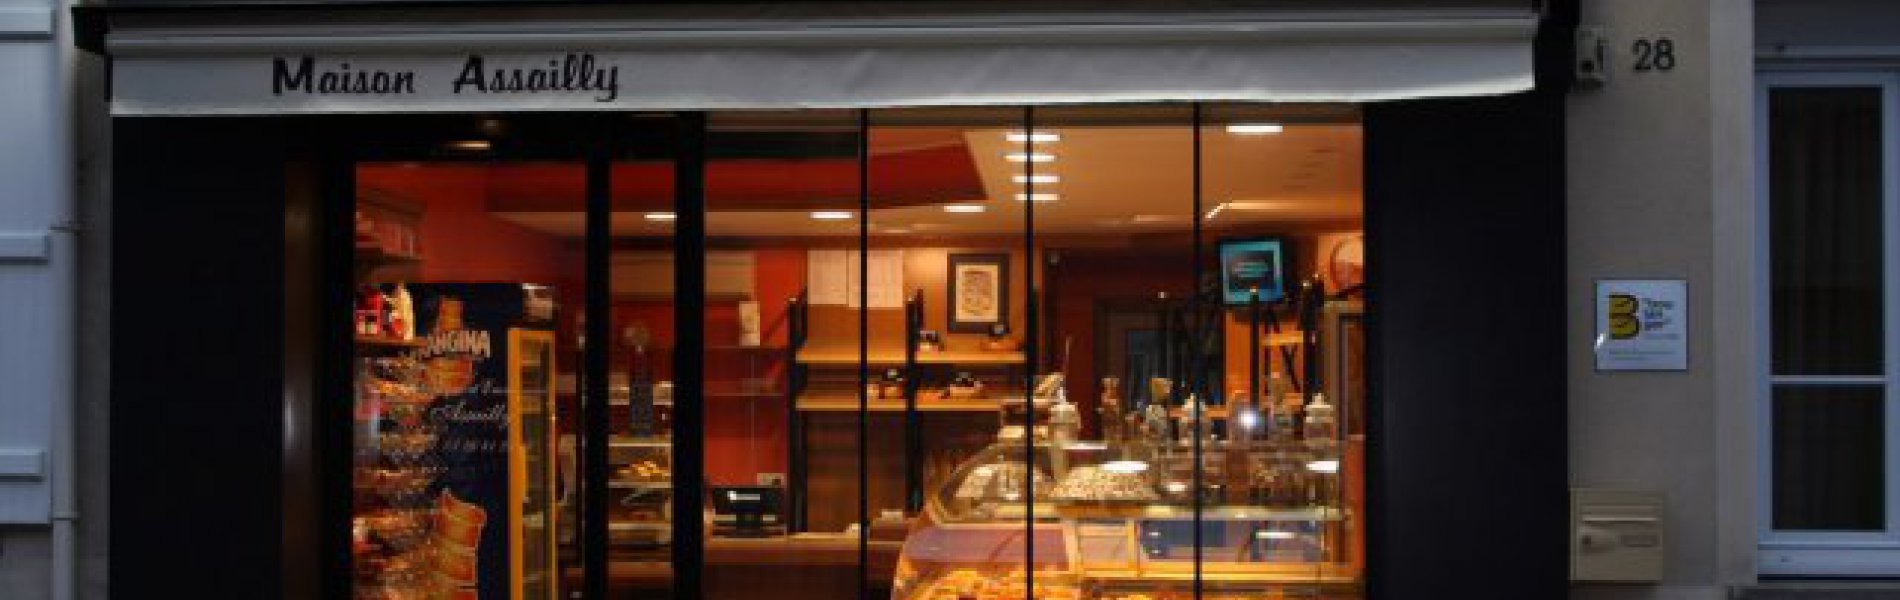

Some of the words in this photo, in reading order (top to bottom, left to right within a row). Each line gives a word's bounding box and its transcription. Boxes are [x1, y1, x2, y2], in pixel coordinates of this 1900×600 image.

[1633, 39, 1675, 71] 28
[273, 56, 415, 95] Maison
[453, 51, 619, 102] Assailly
